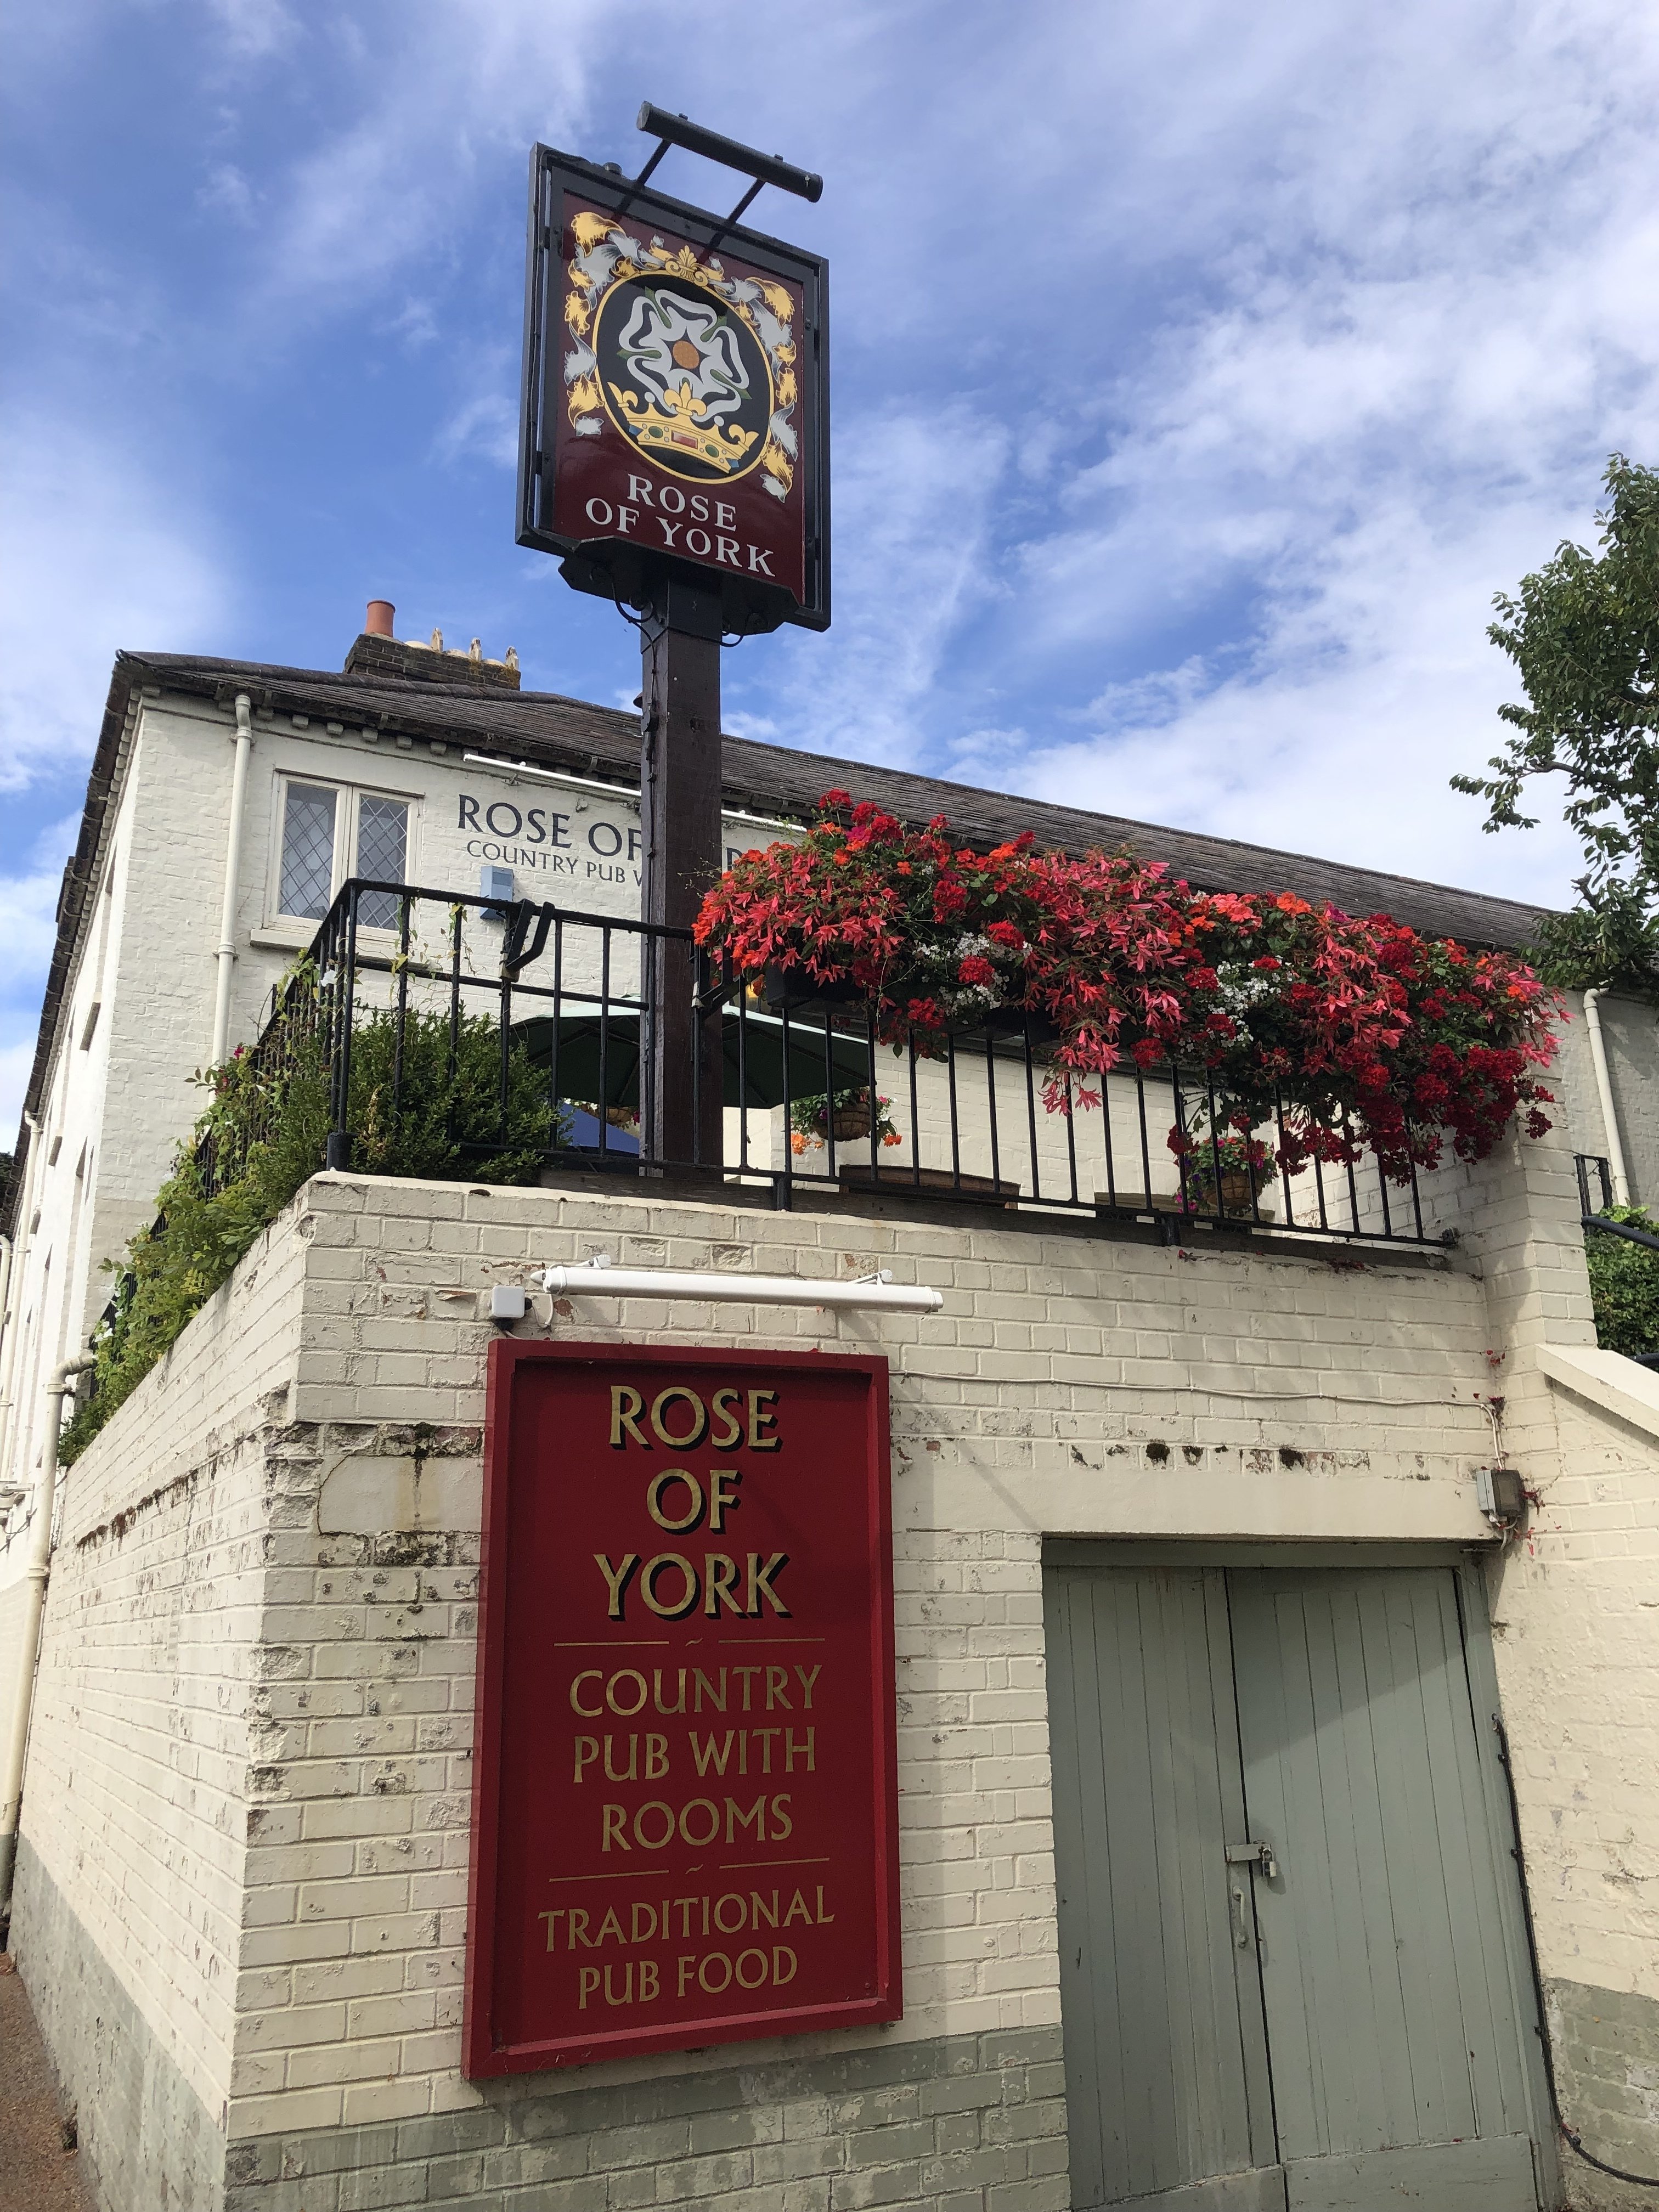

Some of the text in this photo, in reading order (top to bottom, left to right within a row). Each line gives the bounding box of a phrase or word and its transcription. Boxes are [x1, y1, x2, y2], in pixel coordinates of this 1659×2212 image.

[628, 473, 736, 532] ROSE
[585, 498, 776, 577] OF YORK
[458, 794, 573, 849] ROSE
[467, 840, 579, 874] COUNTRY
[586, 861, 625, 883] PUB
[608, 1385, 783, 1453] ROSE
[646, 1468, 743, 1535] OF
[592, 1552, 793, 1621] YORK
[569, 1664, 822, 1717] COUNTRY
[573, 1726, 816, 1784] PUB WITH
[601, 1793, 793, 1852] ROOMS
[537, 1885, 835, 1953] TRADITIONAL
[578, 1945, 798, 2010] PUB FOOD
